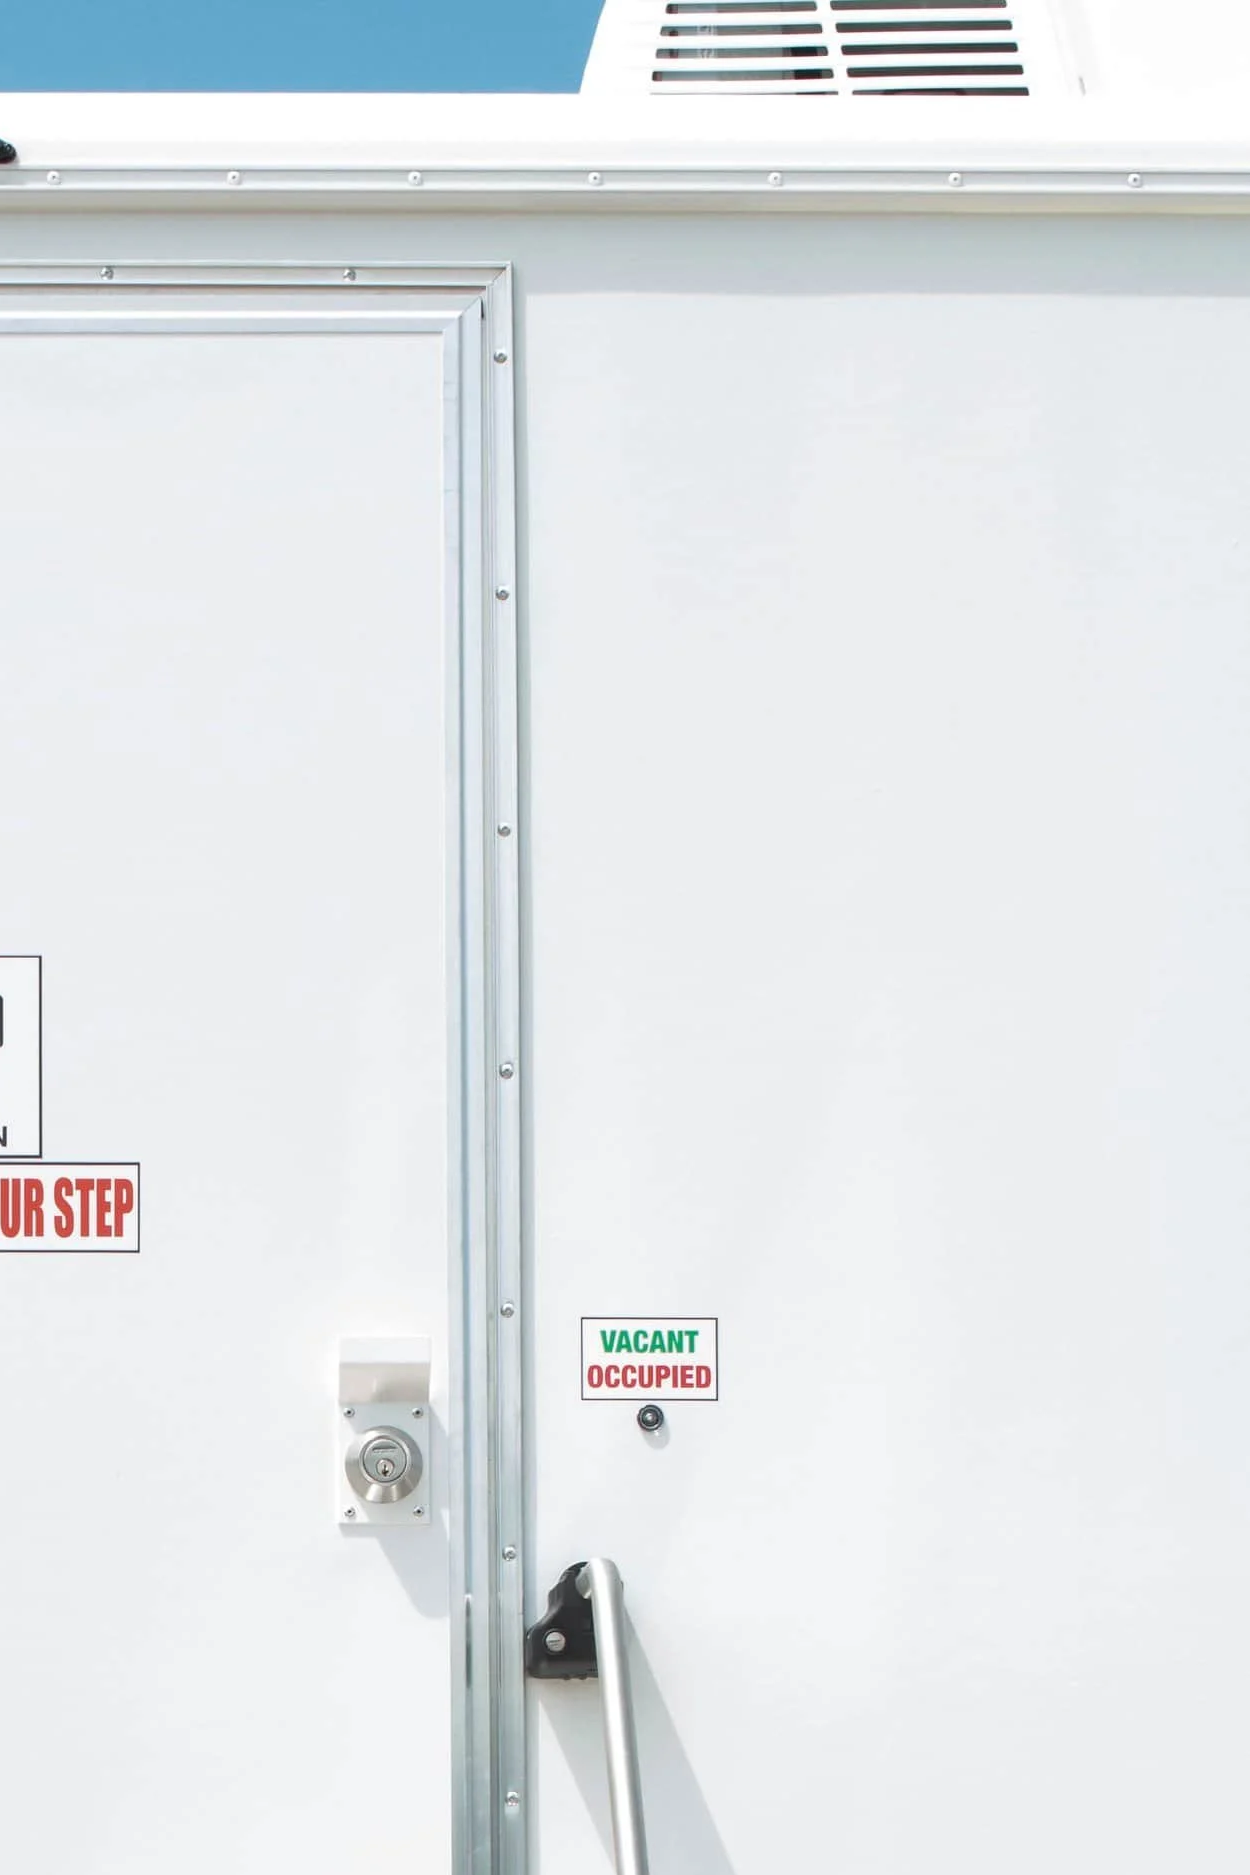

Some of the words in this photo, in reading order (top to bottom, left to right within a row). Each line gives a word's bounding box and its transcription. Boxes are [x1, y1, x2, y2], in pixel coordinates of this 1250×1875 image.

[53, 1176, 134, 1238] STEP
[600, 1329, 699, 1353] VACANT
[587, 1364, 712, 1389] OCCUPIED
